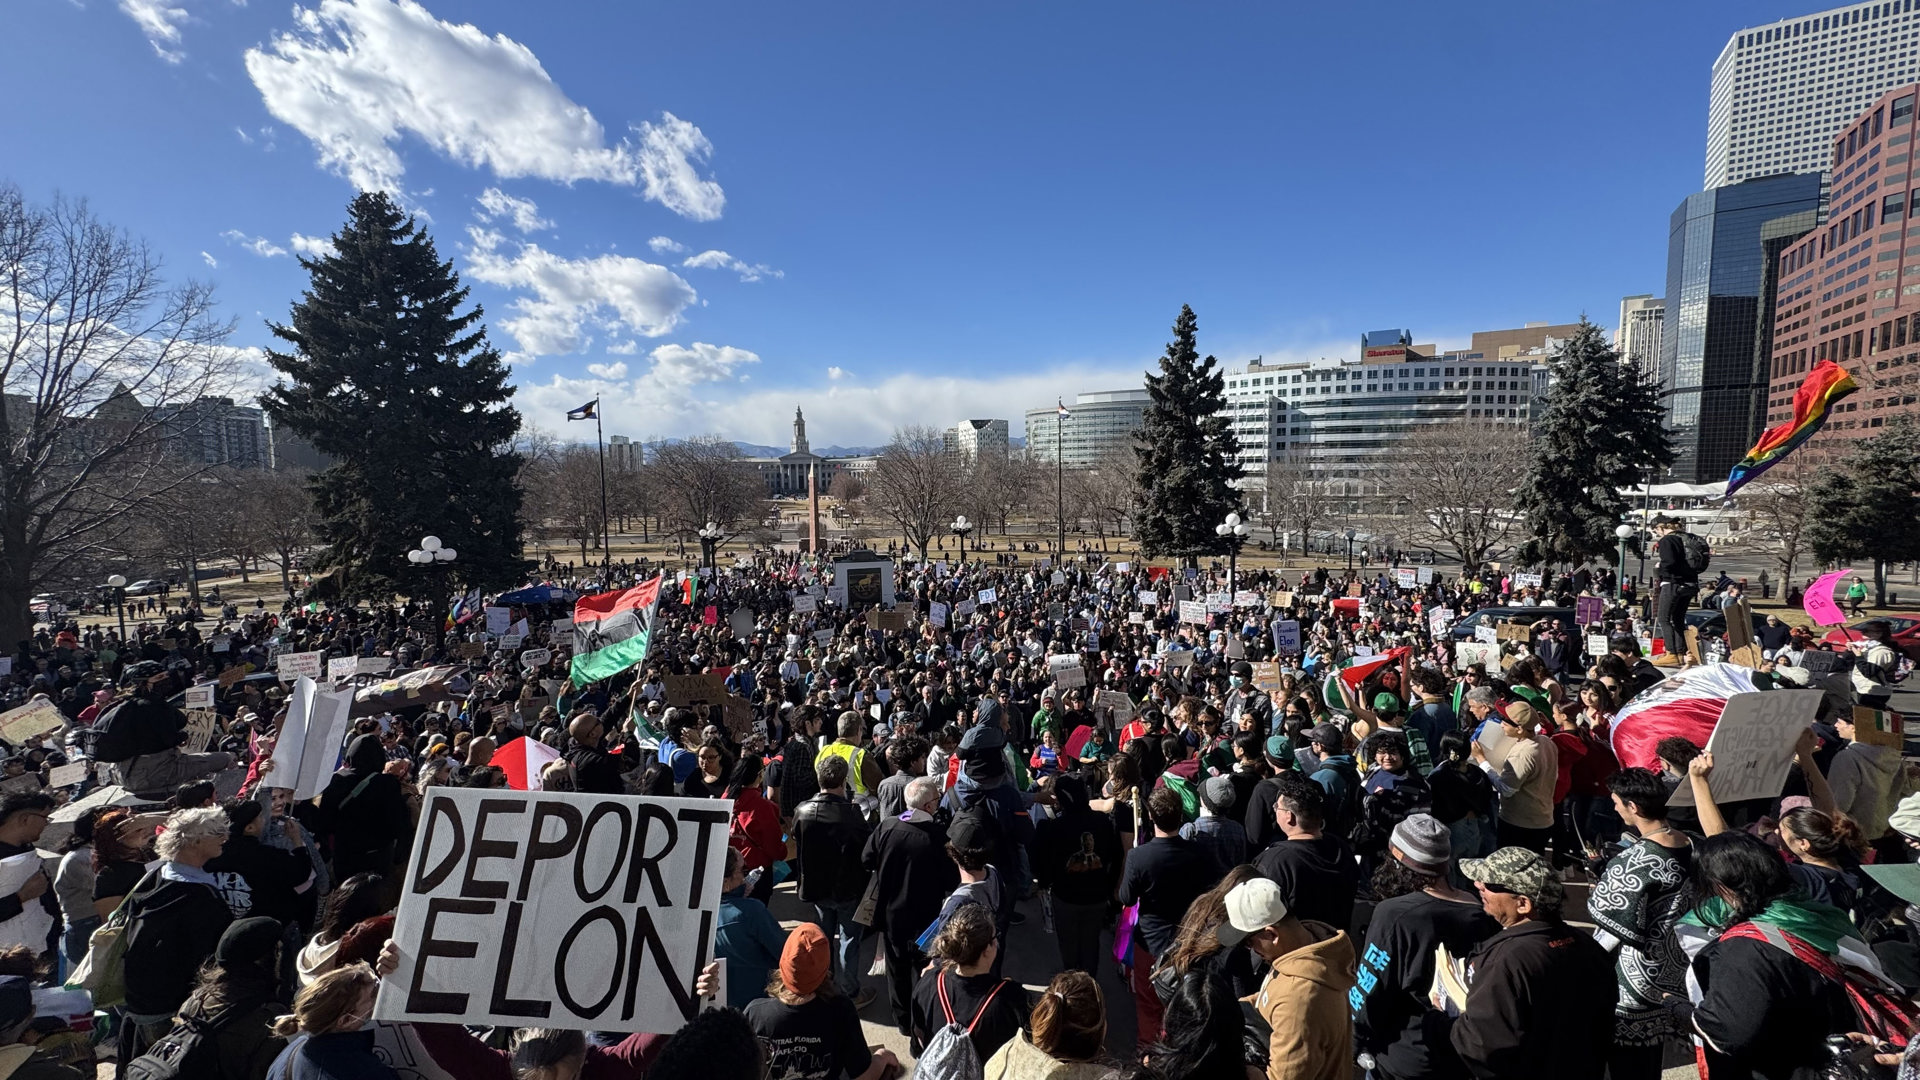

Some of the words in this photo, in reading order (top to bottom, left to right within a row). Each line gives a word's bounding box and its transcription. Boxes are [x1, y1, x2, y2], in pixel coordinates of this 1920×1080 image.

[1367, 349, 1405, 358] Sheraton
[980, 590, 995, 600] FDT
[1280, 636, 1295, 646] Elon
[679, 678, 710, 688] VIVA
[187, 711, 214, 729] GRY
[413, 797, 729, 909] DEPORT
[406, 898, 712, 1022] ELON
[1348, 942, 1391, 1020] 世界的
[772, 1037, 793, 1045] NTRAL
